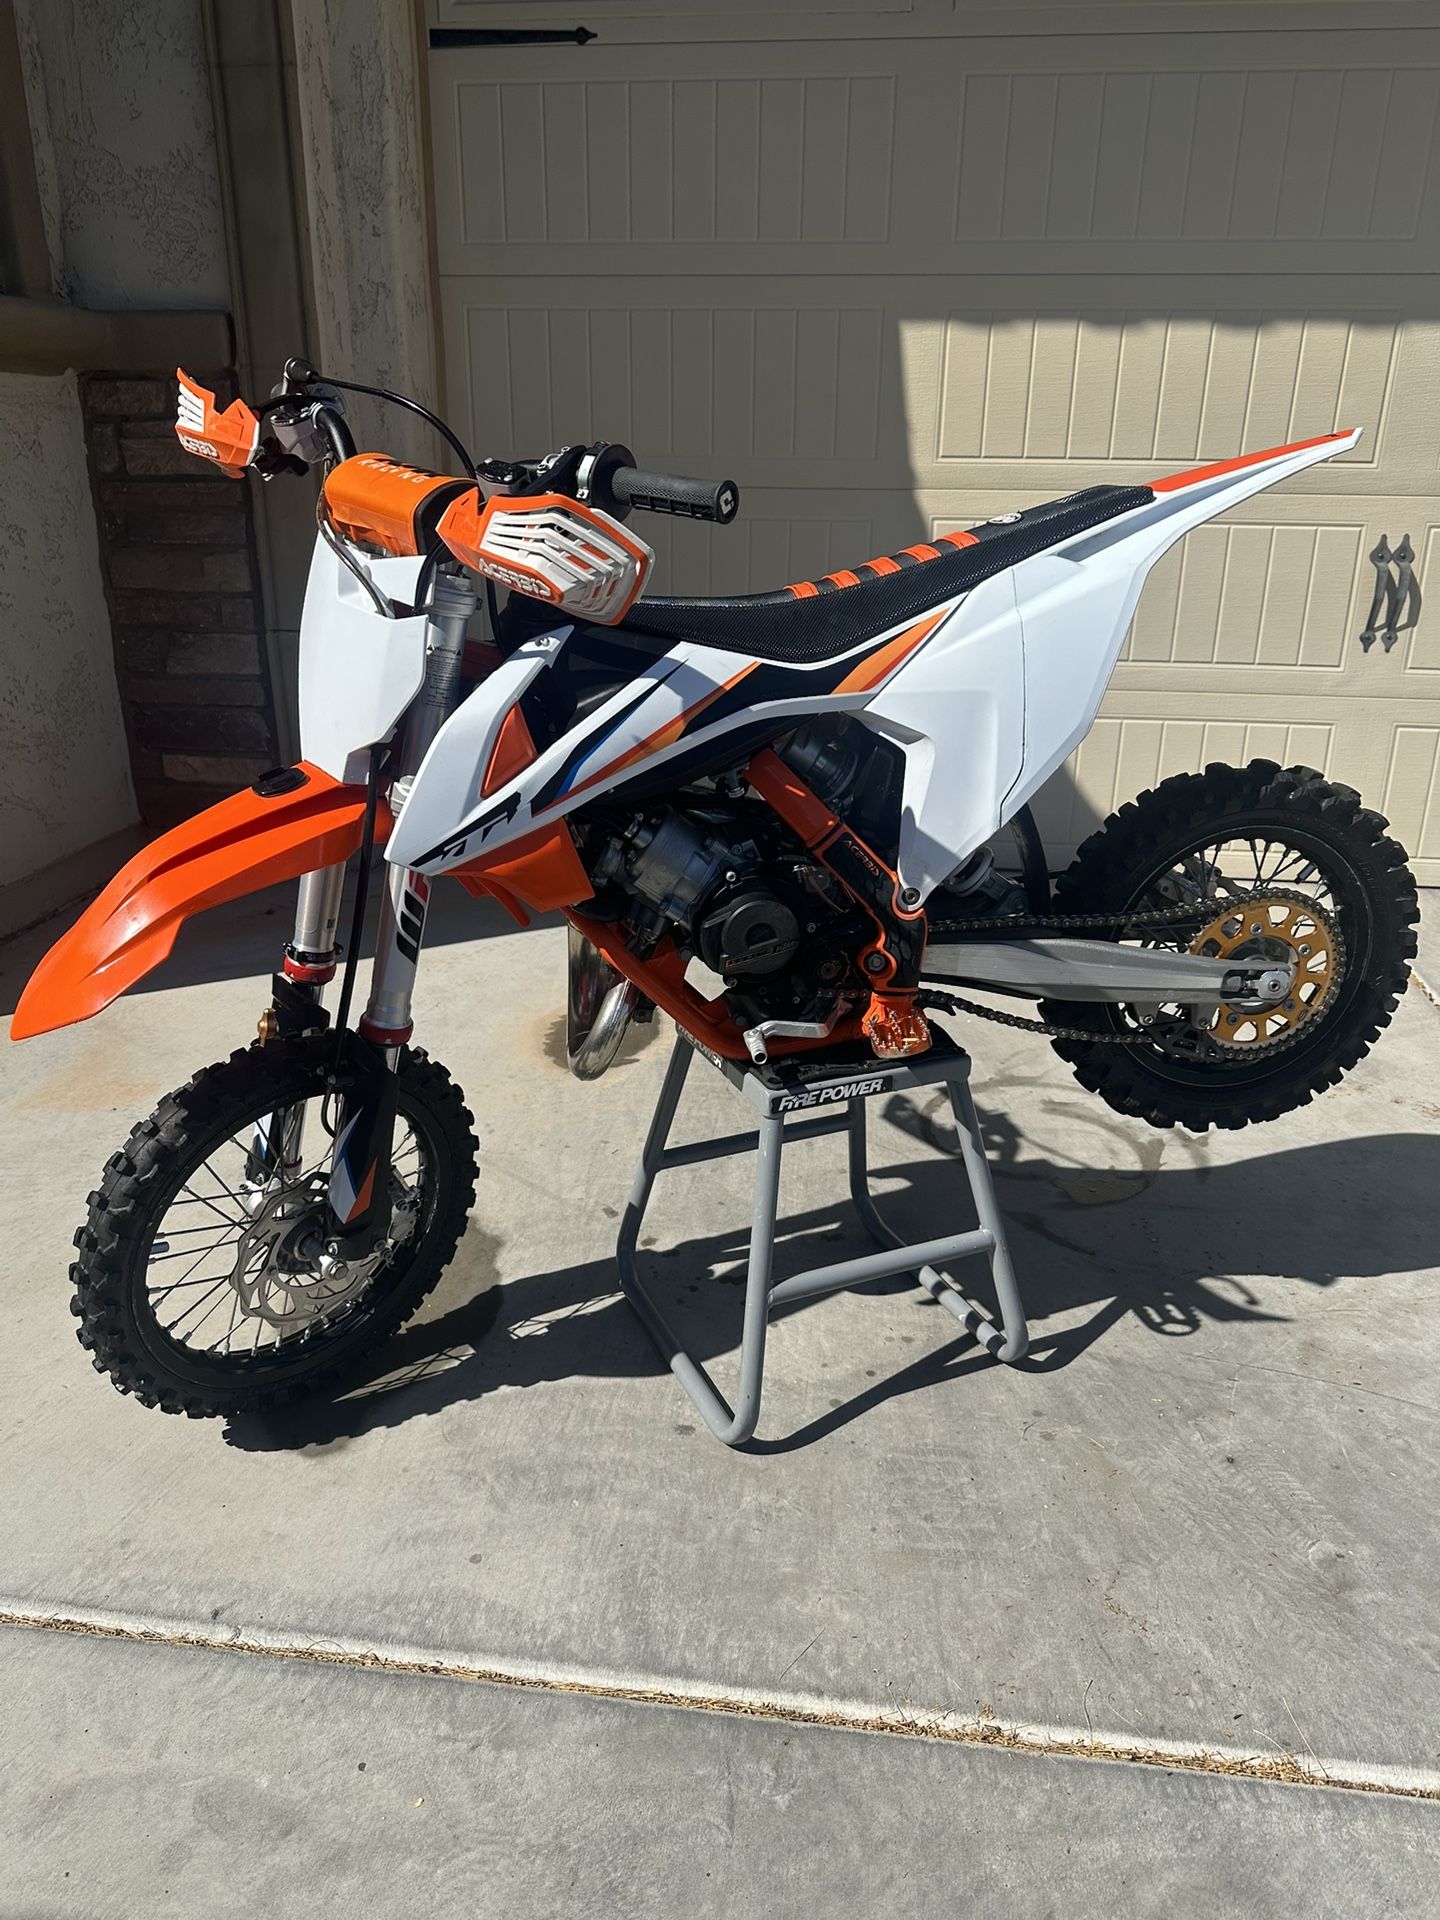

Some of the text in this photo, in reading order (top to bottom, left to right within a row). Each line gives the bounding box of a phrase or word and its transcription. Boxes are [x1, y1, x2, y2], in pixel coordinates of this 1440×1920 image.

[357, 459, 430, 483] RACING
[479, 558, 551, 597] ACERBIS
[778, 1079, 884, 1111] FIRE POWER
